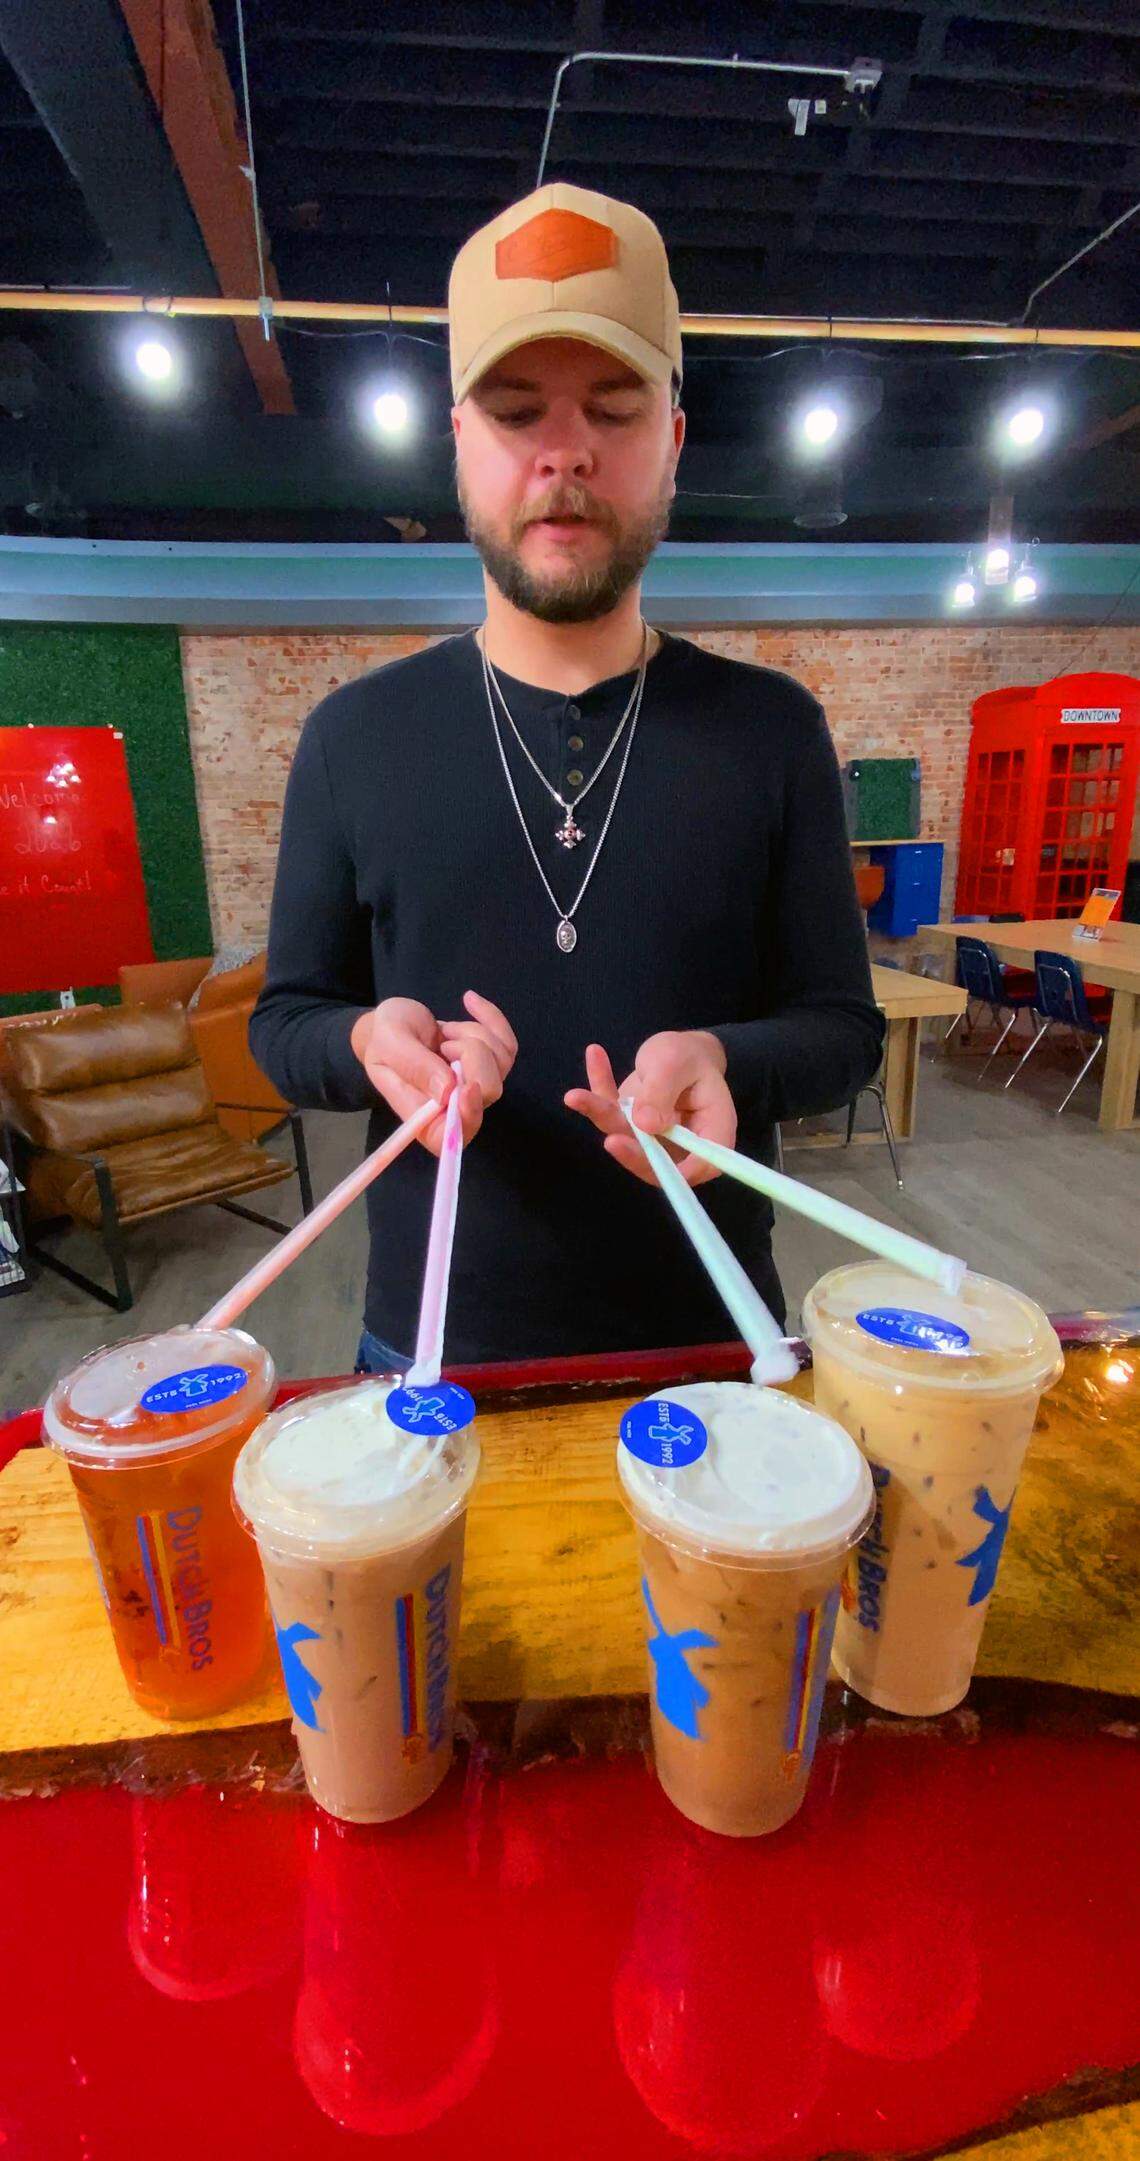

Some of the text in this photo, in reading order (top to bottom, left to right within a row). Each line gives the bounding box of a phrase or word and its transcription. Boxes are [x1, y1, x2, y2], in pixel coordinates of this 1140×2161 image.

[1063, 710, 1118, 721] DOWNTOWN
[661, 1443, 673, 1464] 1992
[858, 1556, 887, 1632] BROS
